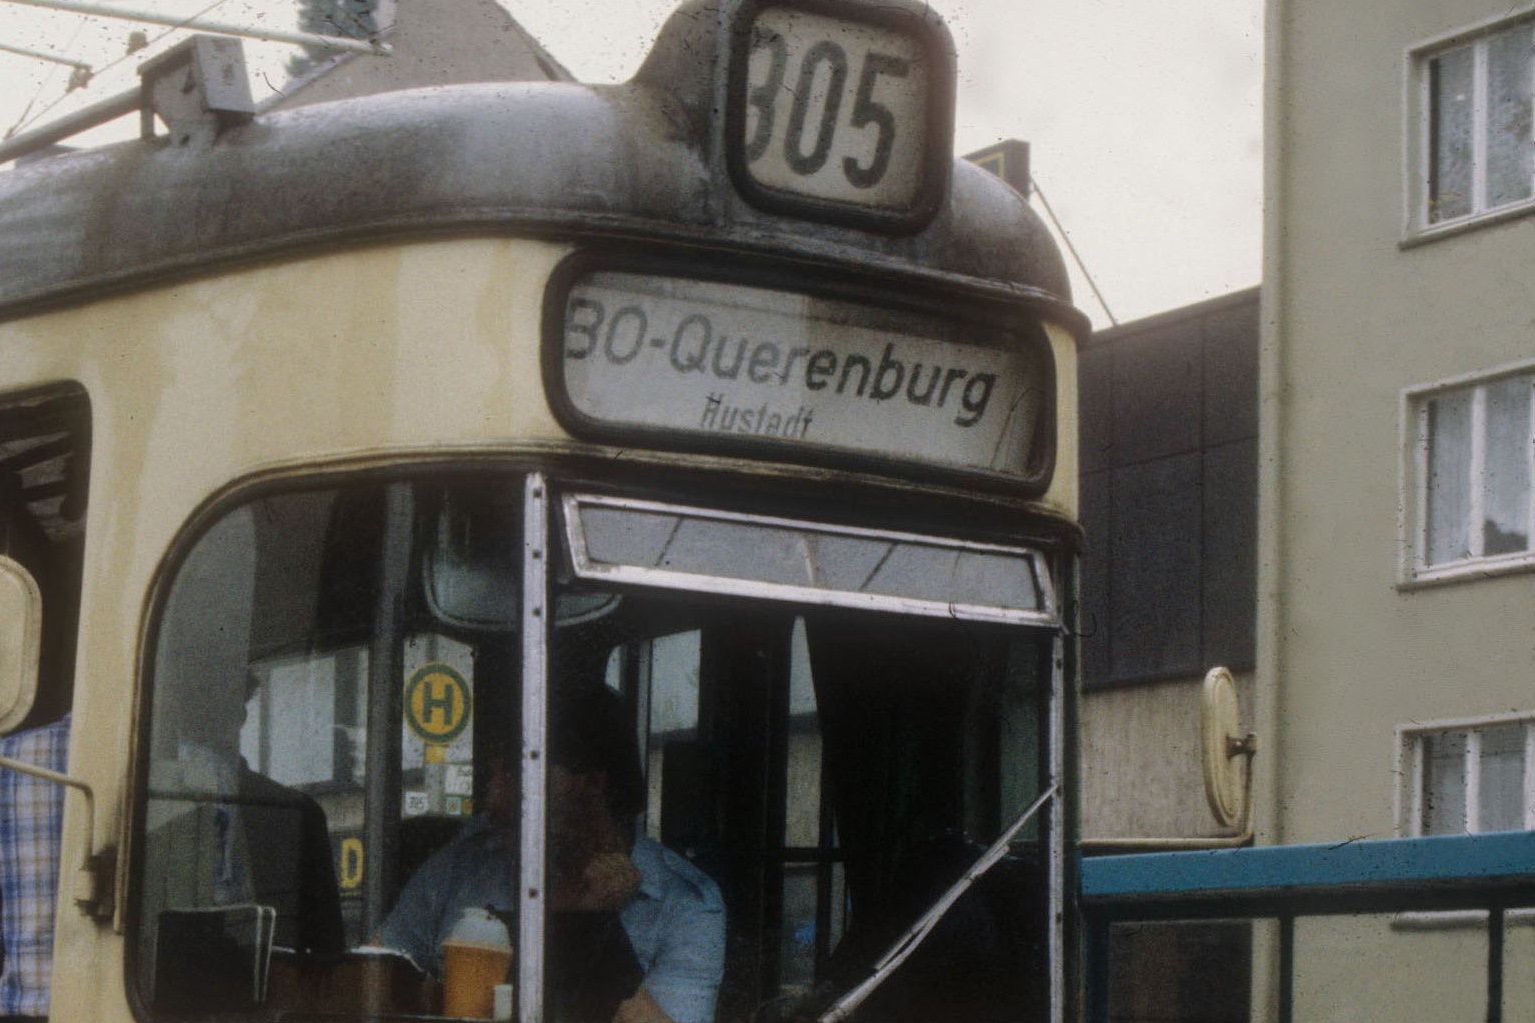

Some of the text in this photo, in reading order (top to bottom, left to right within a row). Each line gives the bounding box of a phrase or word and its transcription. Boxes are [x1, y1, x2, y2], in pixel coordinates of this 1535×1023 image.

[746, 26, 912, 189] 305
[565, 299, 998, 428] BO-Querenburg
[699, 394, 814, 439] Hustadt
[422, 681, 453, 726] H
